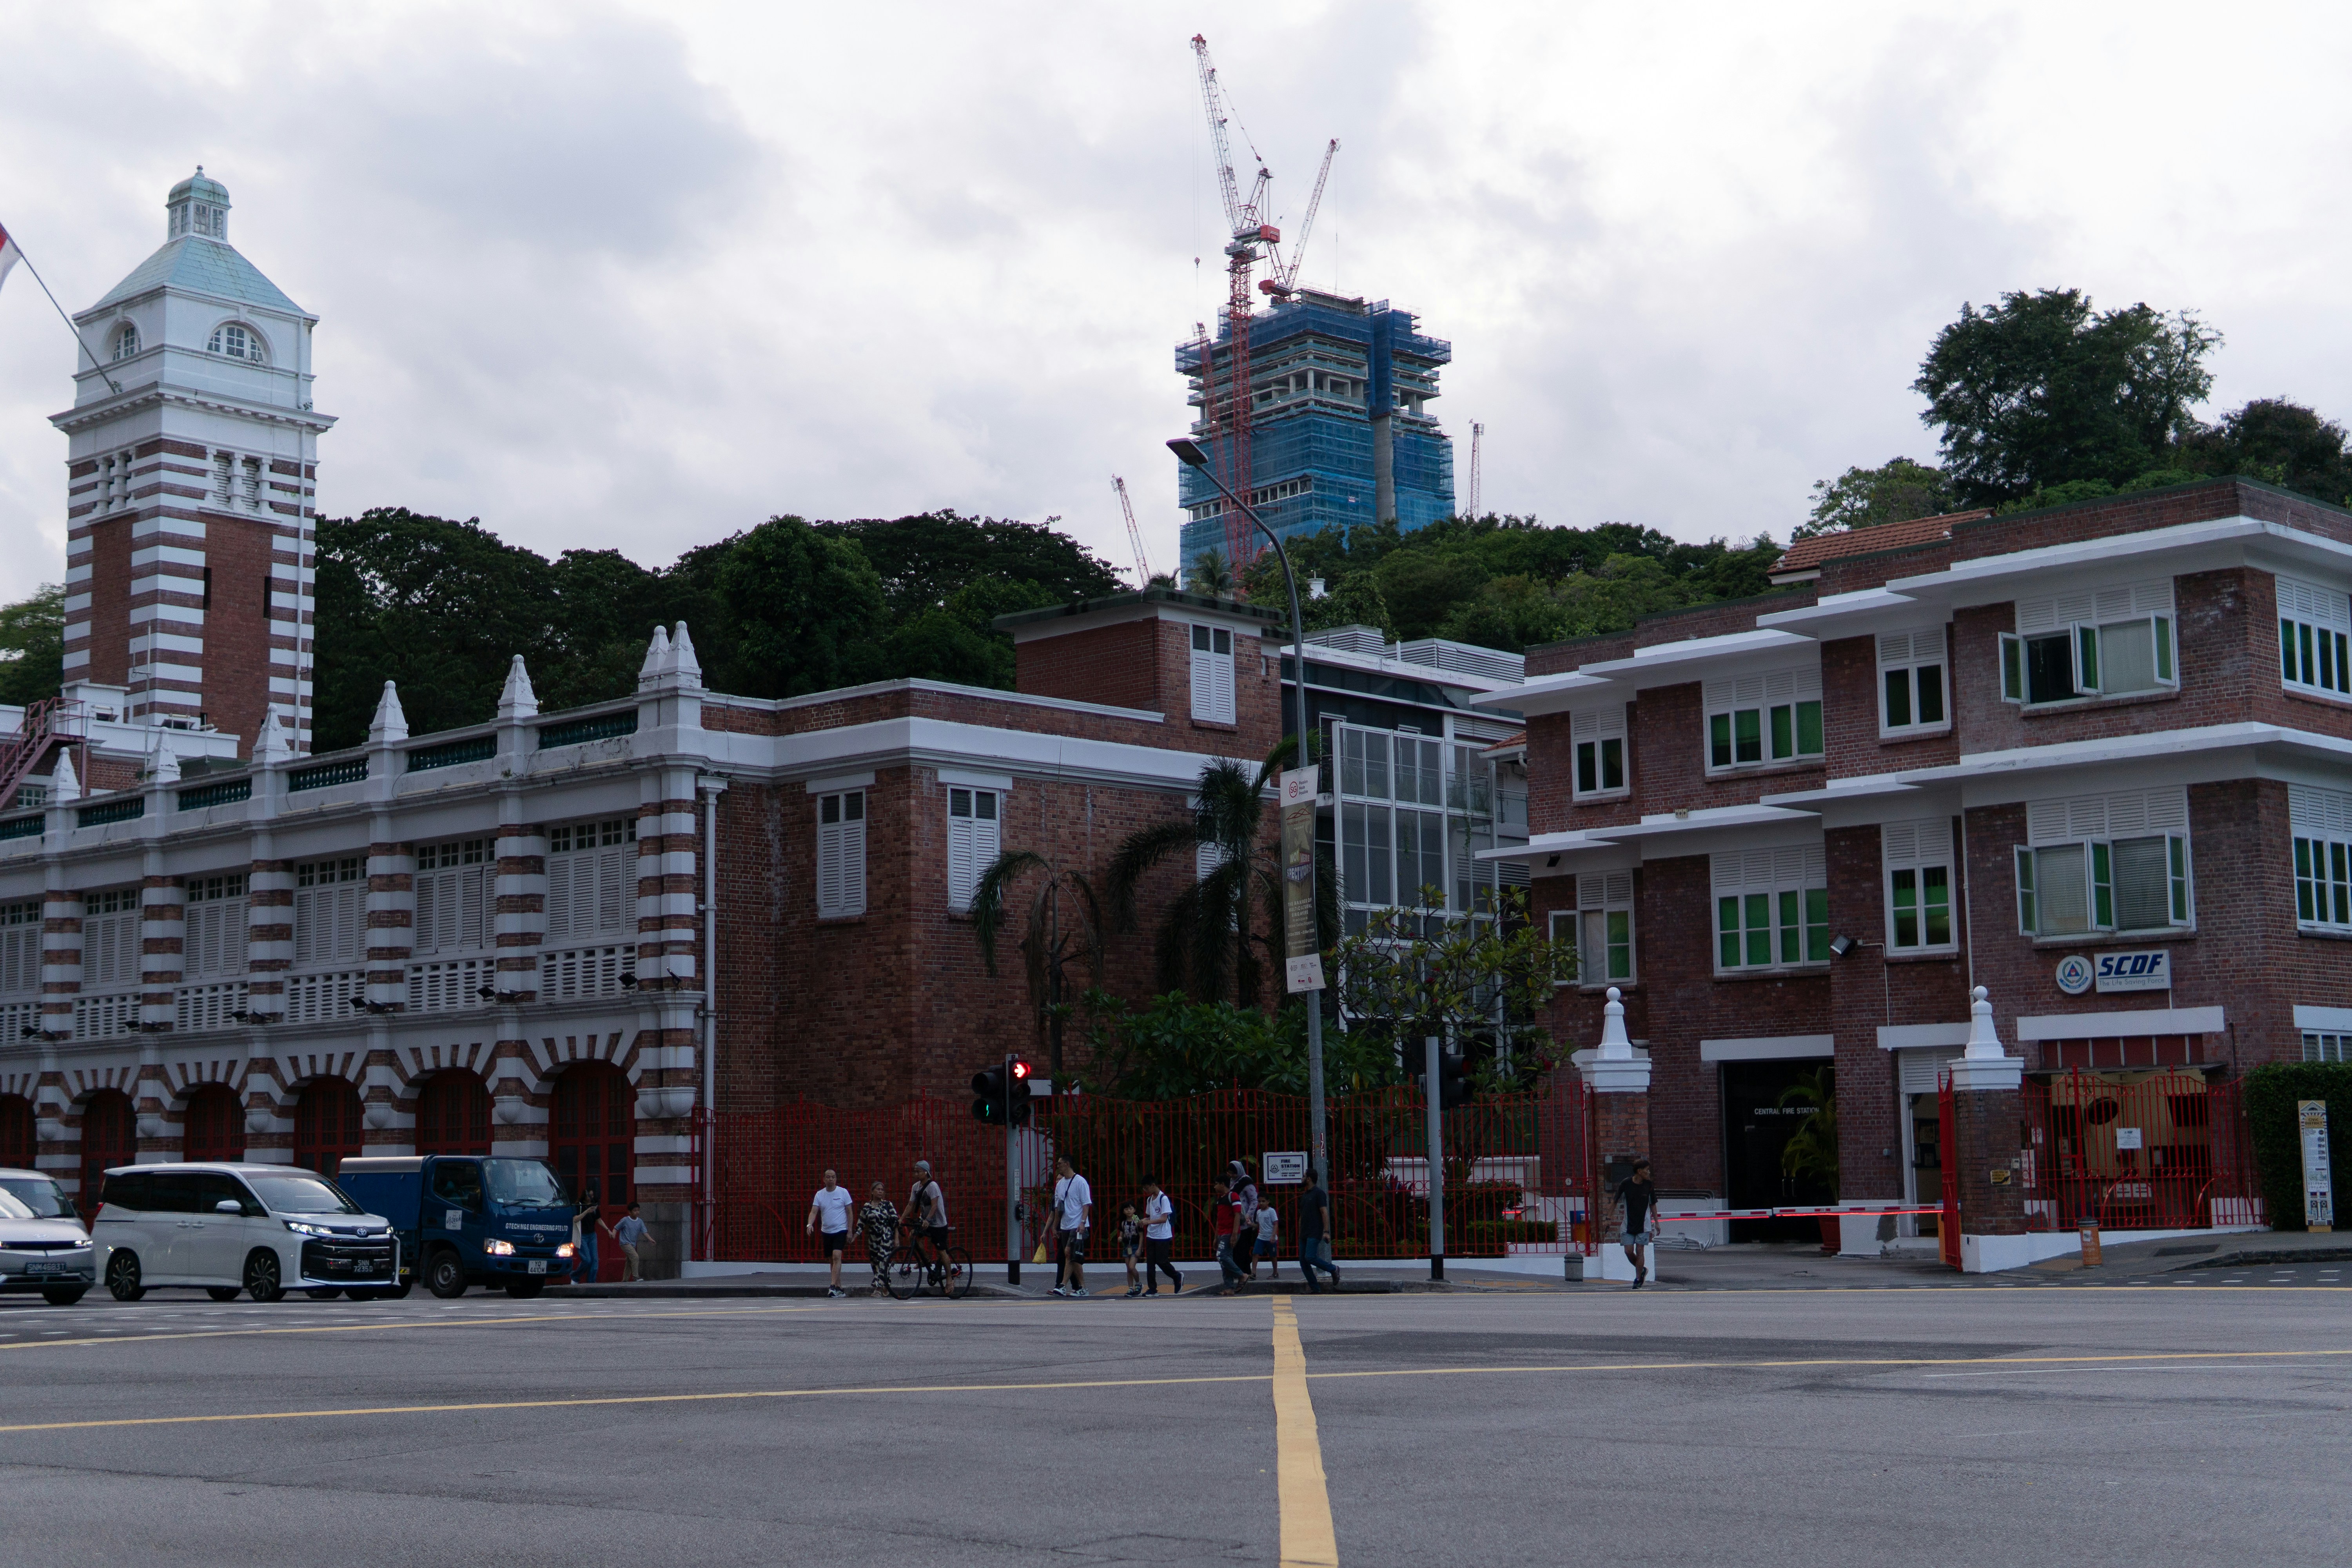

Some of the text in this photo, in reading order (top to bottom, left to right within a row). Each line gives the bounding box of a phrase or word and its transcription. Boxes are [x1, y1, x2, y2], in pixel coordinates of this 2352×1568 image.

[1290, 849, 1310, 863] NOT MERE
[1287, 863, 1311, 880] SPECTATORS
[2098, 954, 2163, 976] SCDF
